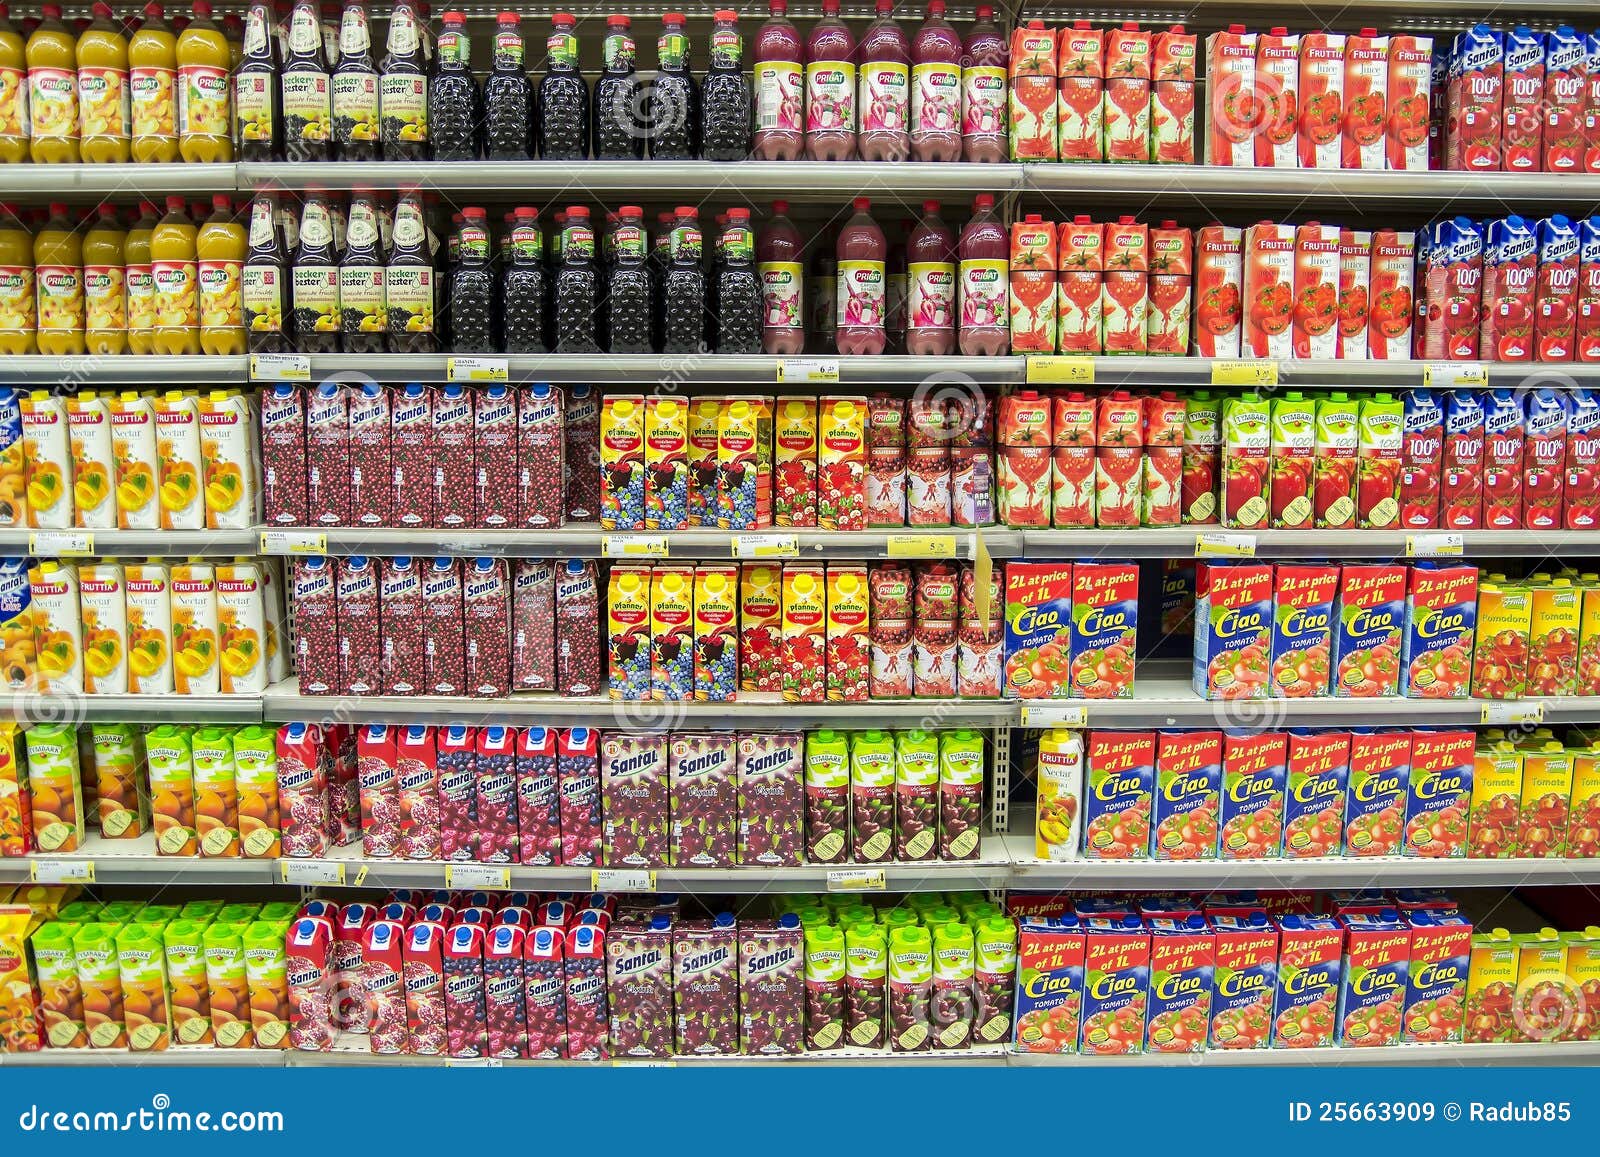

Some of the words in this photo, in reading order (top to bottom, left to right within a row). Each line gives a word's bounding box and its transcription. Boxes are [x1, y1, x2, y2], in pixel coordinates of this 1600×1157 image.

[498, 37, 522, 47] granini
[713, 35, 738, 45] granini
[1025, 40, 1052, 50] PRIGAT
[1170, 45, 1194, 56] PRIGAT
[1467, 46, 1499, 66] Santal
[1508, 48, 1541, 67] Santal
[1552, 48, 1584, 66] Santal
[1316, 64, 1336, 75] Juice
[1361, 64, 1381, 76] Juice
[199, 78, 227, 90] PRIGAT
[816, 72, 845, 84] PRIGAT
[931, 74, 957, 86] PRIGAT
[975, 77, 1002, 88] PRIGAT
[42, 79, 72, 90] PRIGAT
[284, 85, 308, 93] bester
[382, 86, 406, 95] bester
[1471, 77, 1500, 94] 100%
[1554, 77, 1584, 95] 100%
[462, 232, 486, 241] granini
[617, 231, 640, 240] granini
[1020, 235, 1048, 246] PRIGAT
[1155, 240, 1182, 251] PRIGAT
[1453, 240, 1482, 258] Santal
[1503, 238, 1534, 258] Santal
[1213, 256, 1234, 269] Juice
[47, 276, 76, 287] PRIGAT
[157, 272, 186, 283] PRIGAT
[201, 271, 227, 282] PRIGAT
[765, 272, 792, 283] PRIGAT
[855, 271, 881, 282] PRIGAT
[970, 270, 998, 281] PRIGAT
[1506, 267, 1534, 285] 100%
[1548, 268, 1577, 286] 100%
[295, 278, 321, 287] bester
[388, 278, 413, 286] bester
[111, 414, 143, 423] FRUTTIA
[265, 405, 298, 425] Santal
[353, 406, 385, 425] Santal
[522, 405, 555, 425] Santal
[873, 413, 900, 422] PRIGAT
[1017, 413, 1046, 422] PRIGAT
[1110, 413, 1137, 422] PRIGAT
[1406, 412, 1440, 428] Santal
[1531, 411, 1564, 428] Santal
[1410, 439, 1440, 456] 100%
[1493, 439, 1522, 456] 100%
[517, 568, 550, 589] Santal
[1009, 577, 1025, 589] 2L
[1029, 576, 1040, 585] at
[1042, 571, 1068, 586] price
[81, 582, 113, 591] FRUTTIA
[175, 582, 209, 591] FRUTTIA
[218, 582, 252, 591] FRUTTIA
[297, 576, 329, 596] Santal
[384, 577, 417, 596] Santal
[879, 585, 906, 595] PRIGAT
[926, 586, 953, 596] PRIGAT
[1417, 581, 1433, 594] 2L
[1435, 580, 1447, 591] at
[1449, 576, 1475, 590] price
[1021, 592, 1035, 605] of
[1038, 588, 1051, 601] 1L
[1427, 596, 1440, 608] of
[1443, 592, 1456, 604] 1L
[1012, 607, 1059, 636] Ciao
[1482, 614, 1529, 625] Pomodoro
[1541, 612, 1573, 621] Tomate
[1417, 609, 1463, 637] Ciao
[1022, 635, 1053, 647] TOMATO
[1427, 636, 1457, 648] TOMATO
[1053, 686, 1066, 697] 2L
[1455, 686, 1467, 696] 2L
[1095, 744, 1110, 757] 2L
[1113, 744, 1123, 753] at
[1125, 739, 1151, 754] price
[611, 750, 658, 777] Santal
[679, 749, 726, 777] Santal
[746, 748, 793, 775] Santal
[1042, 753, 1074, 763] FRUTTIA
[1105, 758, 1118, 770] of
[1121, 755, 1134, 767] 1L
[362, 768, 395, 788] Santal
[1045, 766, 1071, 778] Nectar
[281, 770, 314, 788] Santal
[1480, 777, 1515, 787] Tomate
[1532, 777, 1566, 787] Tomate
[521, 775, 554, 796] Santal
[1096, 773, 1141, 801] Ciao
[1105, 800, 1135, 812] TOMATO
[1133, 848, 1146, 857] 2L
[1013, 907, 1028, 917] 2L
[1029, 905, 1040, 915] at
[1041, 902, 1064, 914] price
[1413, 936, 1429, 949] 2L
[1431, 936, 1442, 945] at
[1444, 932, 1470, 946] price
[1025, 943, 1040, 956] 2L
[1042, 943, 1053, 952] at
[1055, 940, 1081, 955] price
[1423, 950, 1436, 962] of
[1438, 946, 1451, 958] 1L
[682, 947, 729, 974] Santal
[748, 947, 795, 974] Santal
[1035, 957, 1048, 969] of
[1051, 954, 1064, 967] 1L
[289, 968, 321, 986] Santal
[1413, 964, 1457, 989] Ciao
[1478, 966, 1511, 976] Tomate
[448, 975, 481, 994] Santal
[528, 976, 562, 996] Santal
[1025, 972, 1070, 1000] Ciao
[1422, 986, 1451, 1000] TOMATO
[1034, 997, 1064, 1009] TOMATO
[1446, 1031, 1459, 1041] 2L
[1061, 1043, 1074, 1052] 2L
